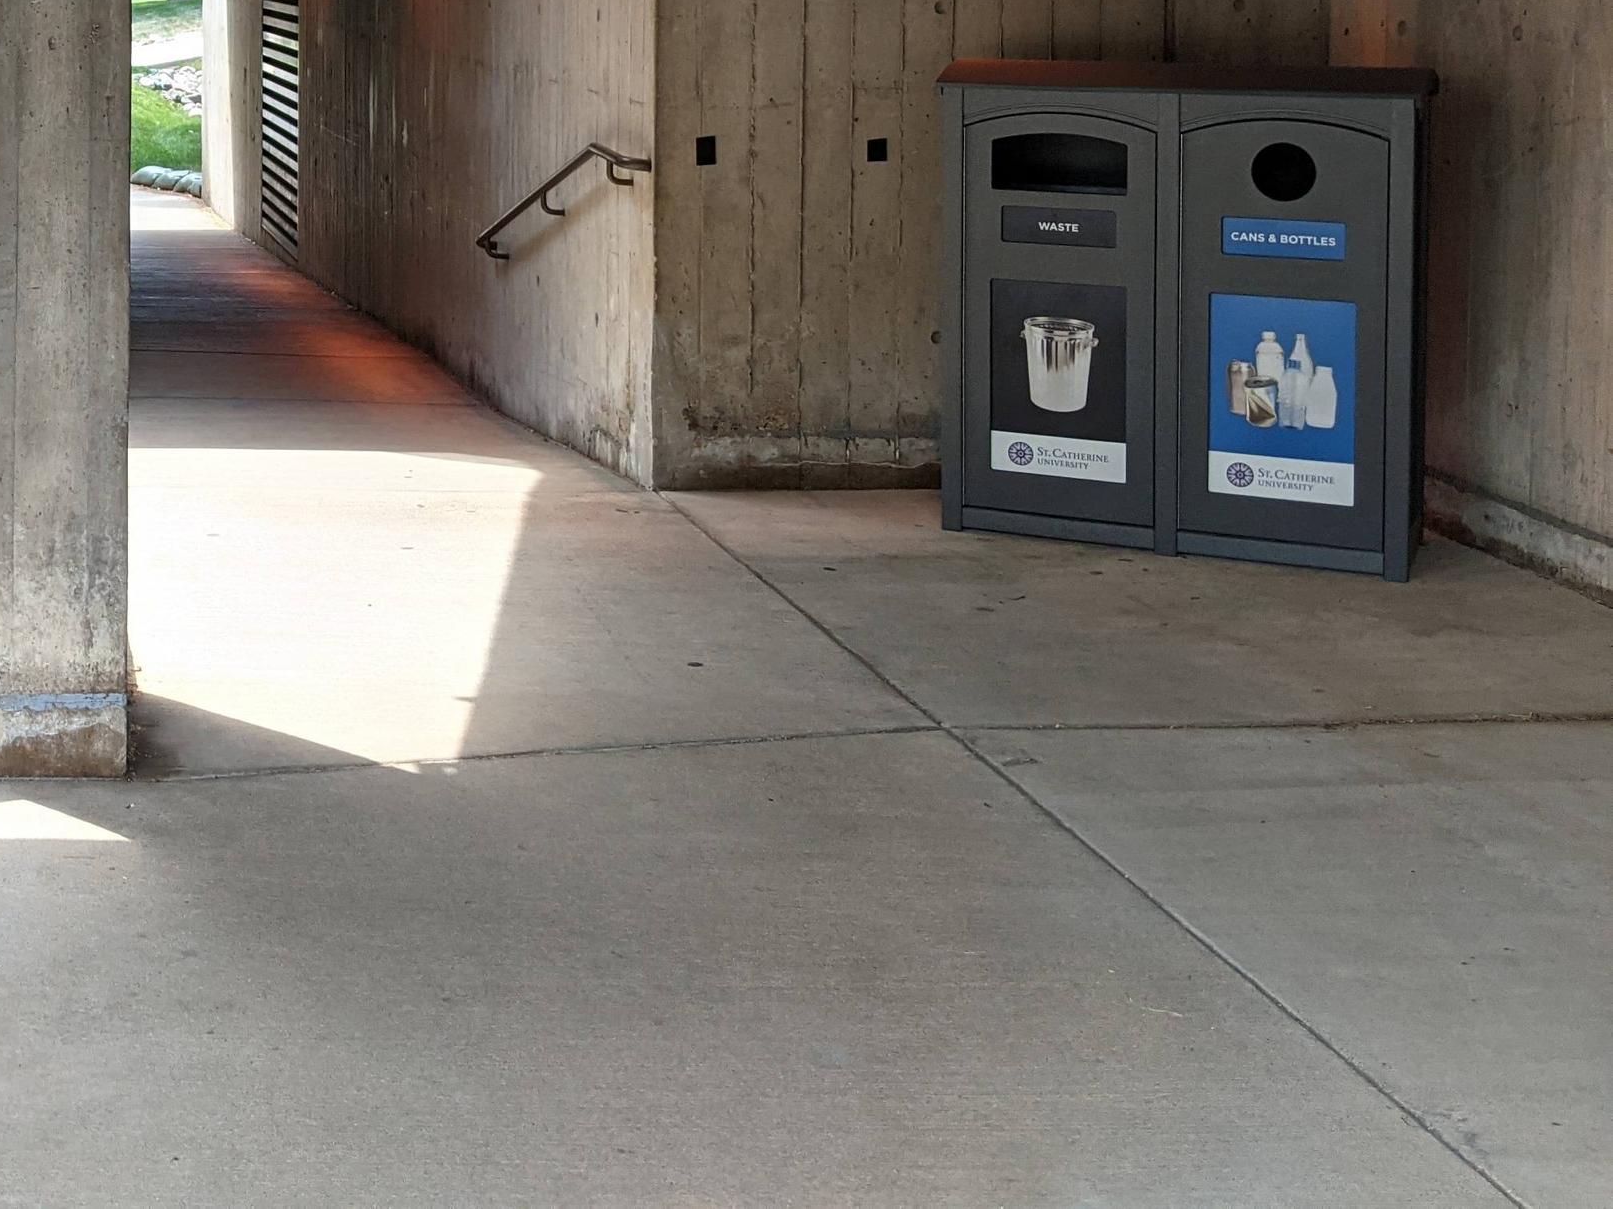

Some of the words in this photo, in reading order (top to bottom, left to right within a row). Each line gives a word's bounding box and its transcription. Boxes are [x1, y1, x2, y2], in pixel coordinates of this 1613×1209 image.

[1038, 221, 1079, 233] WASTE
[1230, 231, 1265, 243] CANS
[1268, 233, 1277, 244] &
[1279, 234, 1336, 247] BOTTLES
[1052, 448, 1109, 463] CATHERINE
[1037, 457, 1089, 470] UNIVERSITY
[1274, 469, 1335, 485] CATHERINE
[1258, 479, 1313, 492] UNIVERSITY
